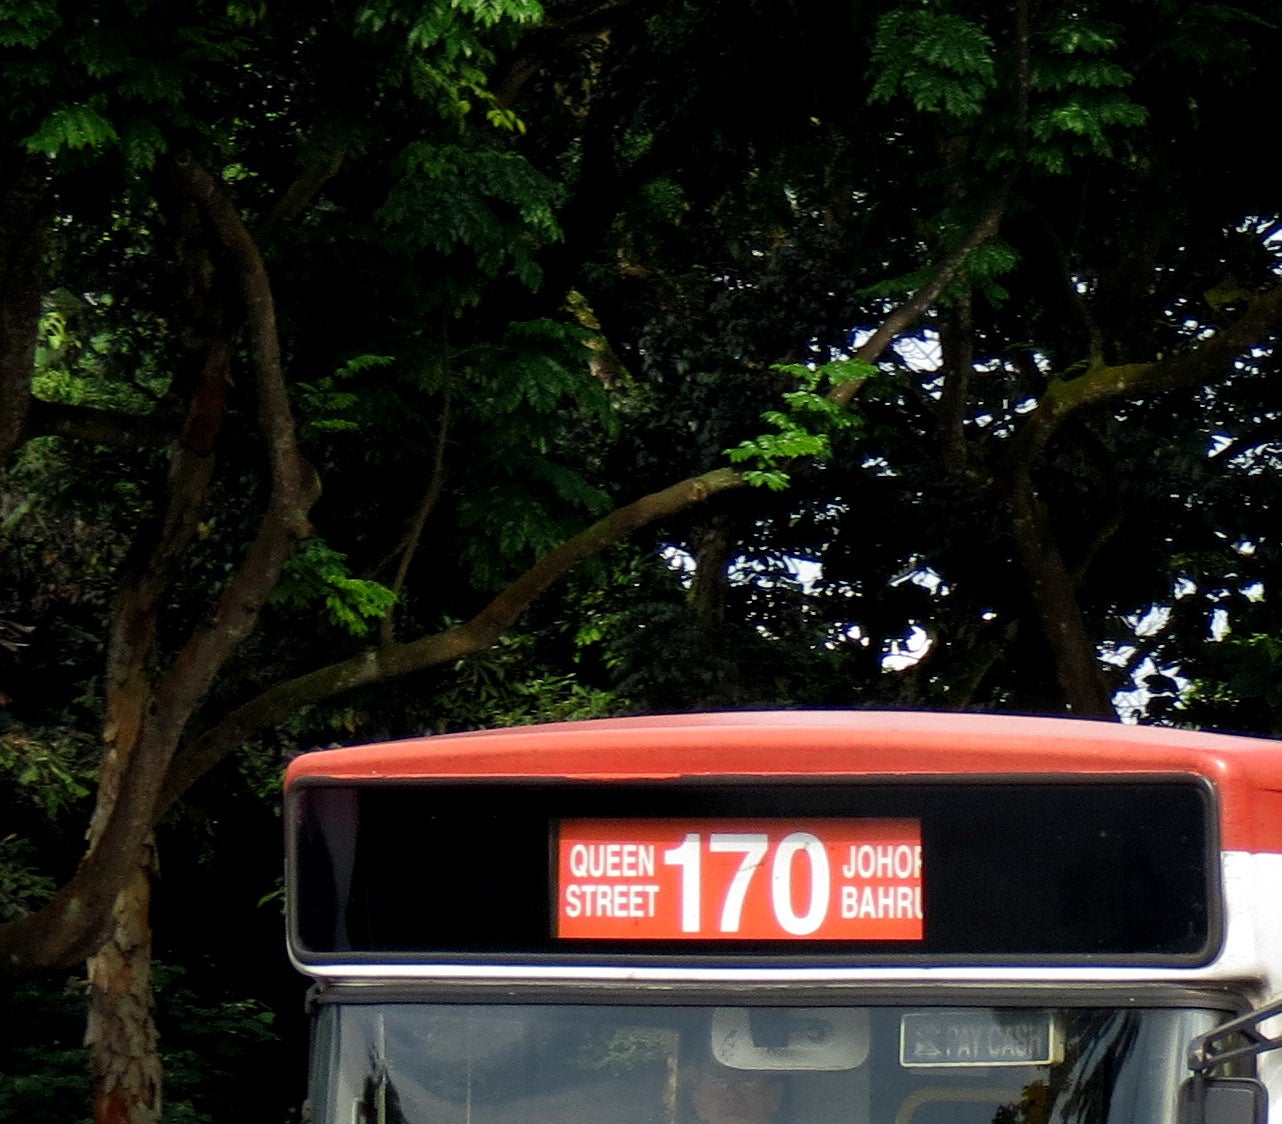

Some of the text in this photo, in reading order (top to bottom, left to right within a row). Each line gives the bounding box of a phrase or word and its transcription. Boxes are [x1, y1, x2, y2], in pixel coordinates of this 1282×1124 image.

[569, 844, 655, 878] QUEEN
[664, 831, 832, 936] 170
[565, 884, 660, 918] STREET
